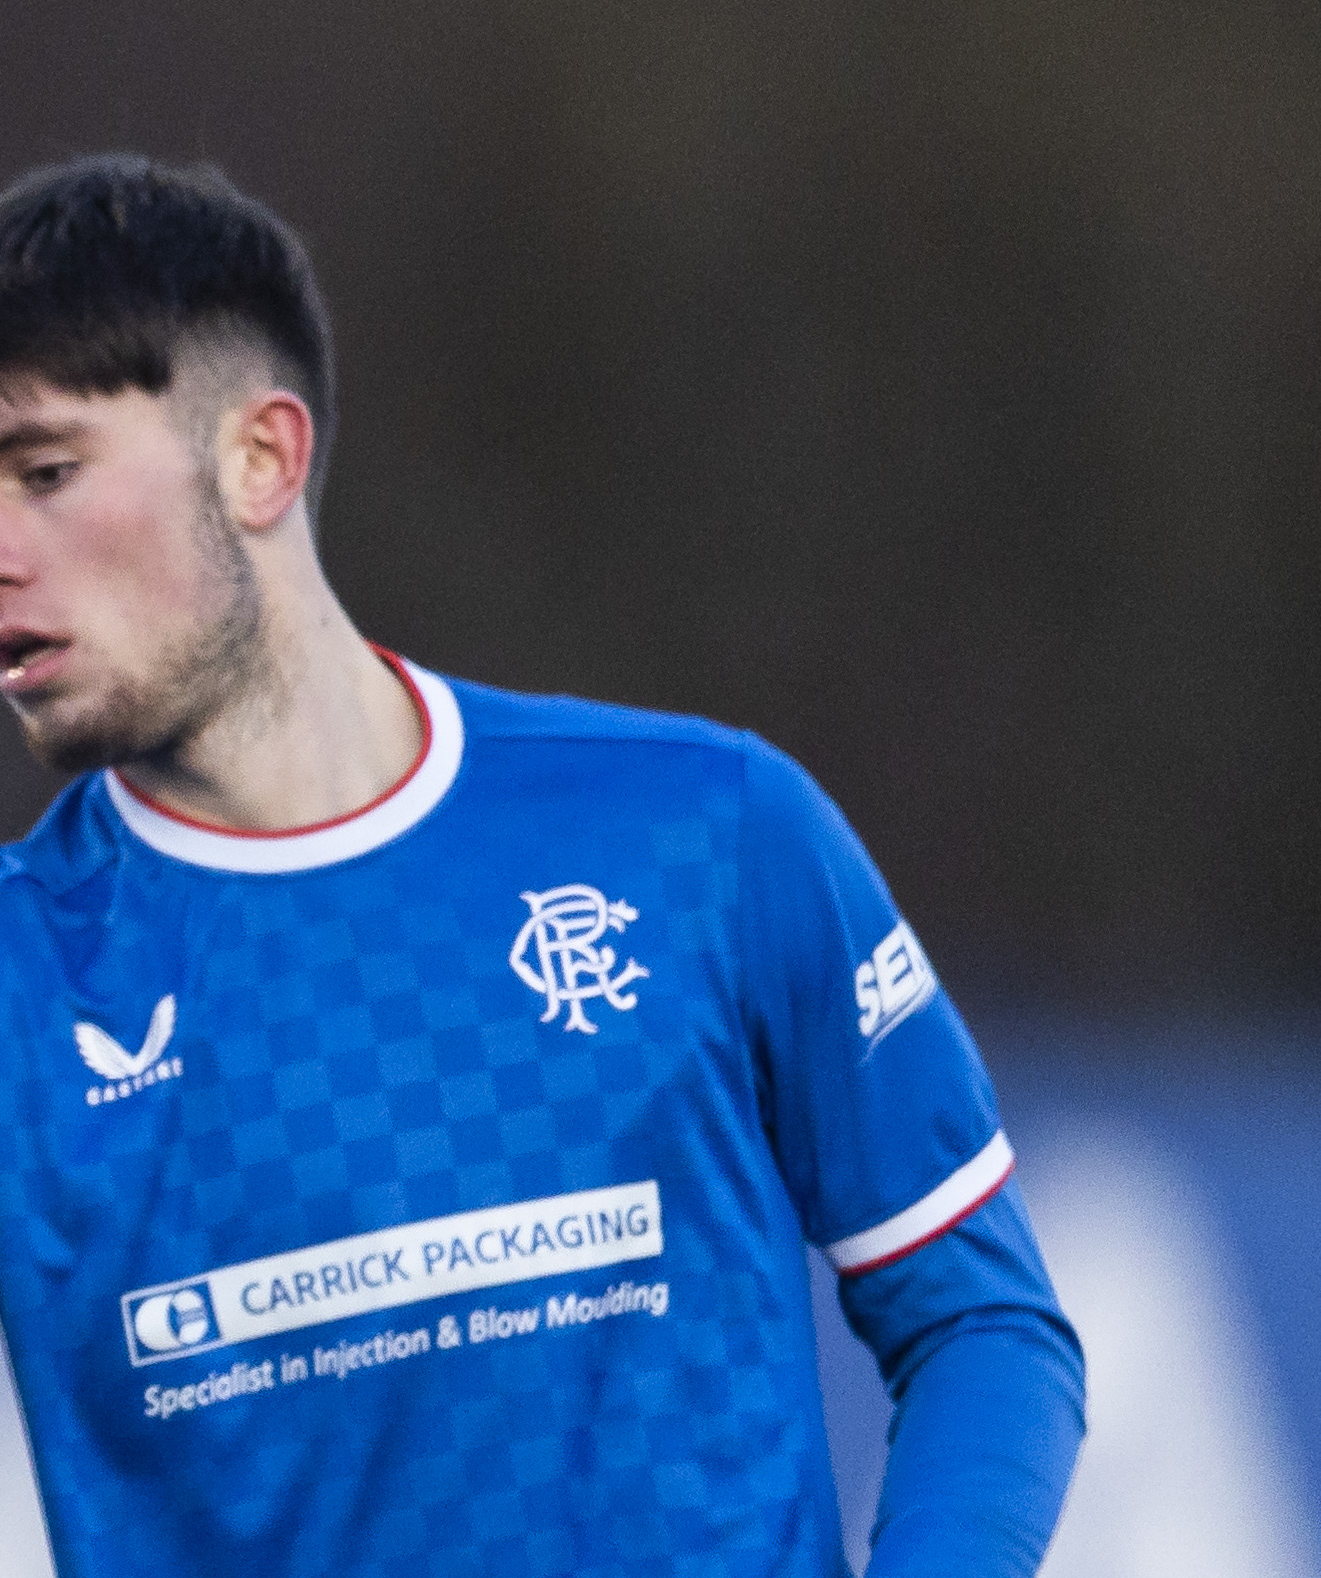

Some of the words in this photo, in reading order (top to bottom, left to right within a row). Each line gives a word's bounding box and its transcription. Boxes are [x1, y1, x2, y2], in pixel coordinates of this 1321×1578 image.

[240, 1249, 410, 1316] CARRICK
[421, 1203, 649, 1276] PACKAGING
[143, 1360, 275, 1420] Specialist
[281, 1352, 309, 1384] in
[313, 1327, 431, 1380] Injection
[436, 1314, 462, 1351] &
[468, 1305, 540, 1345] Blow
[545, 1280, 670, 1328] Moulding
